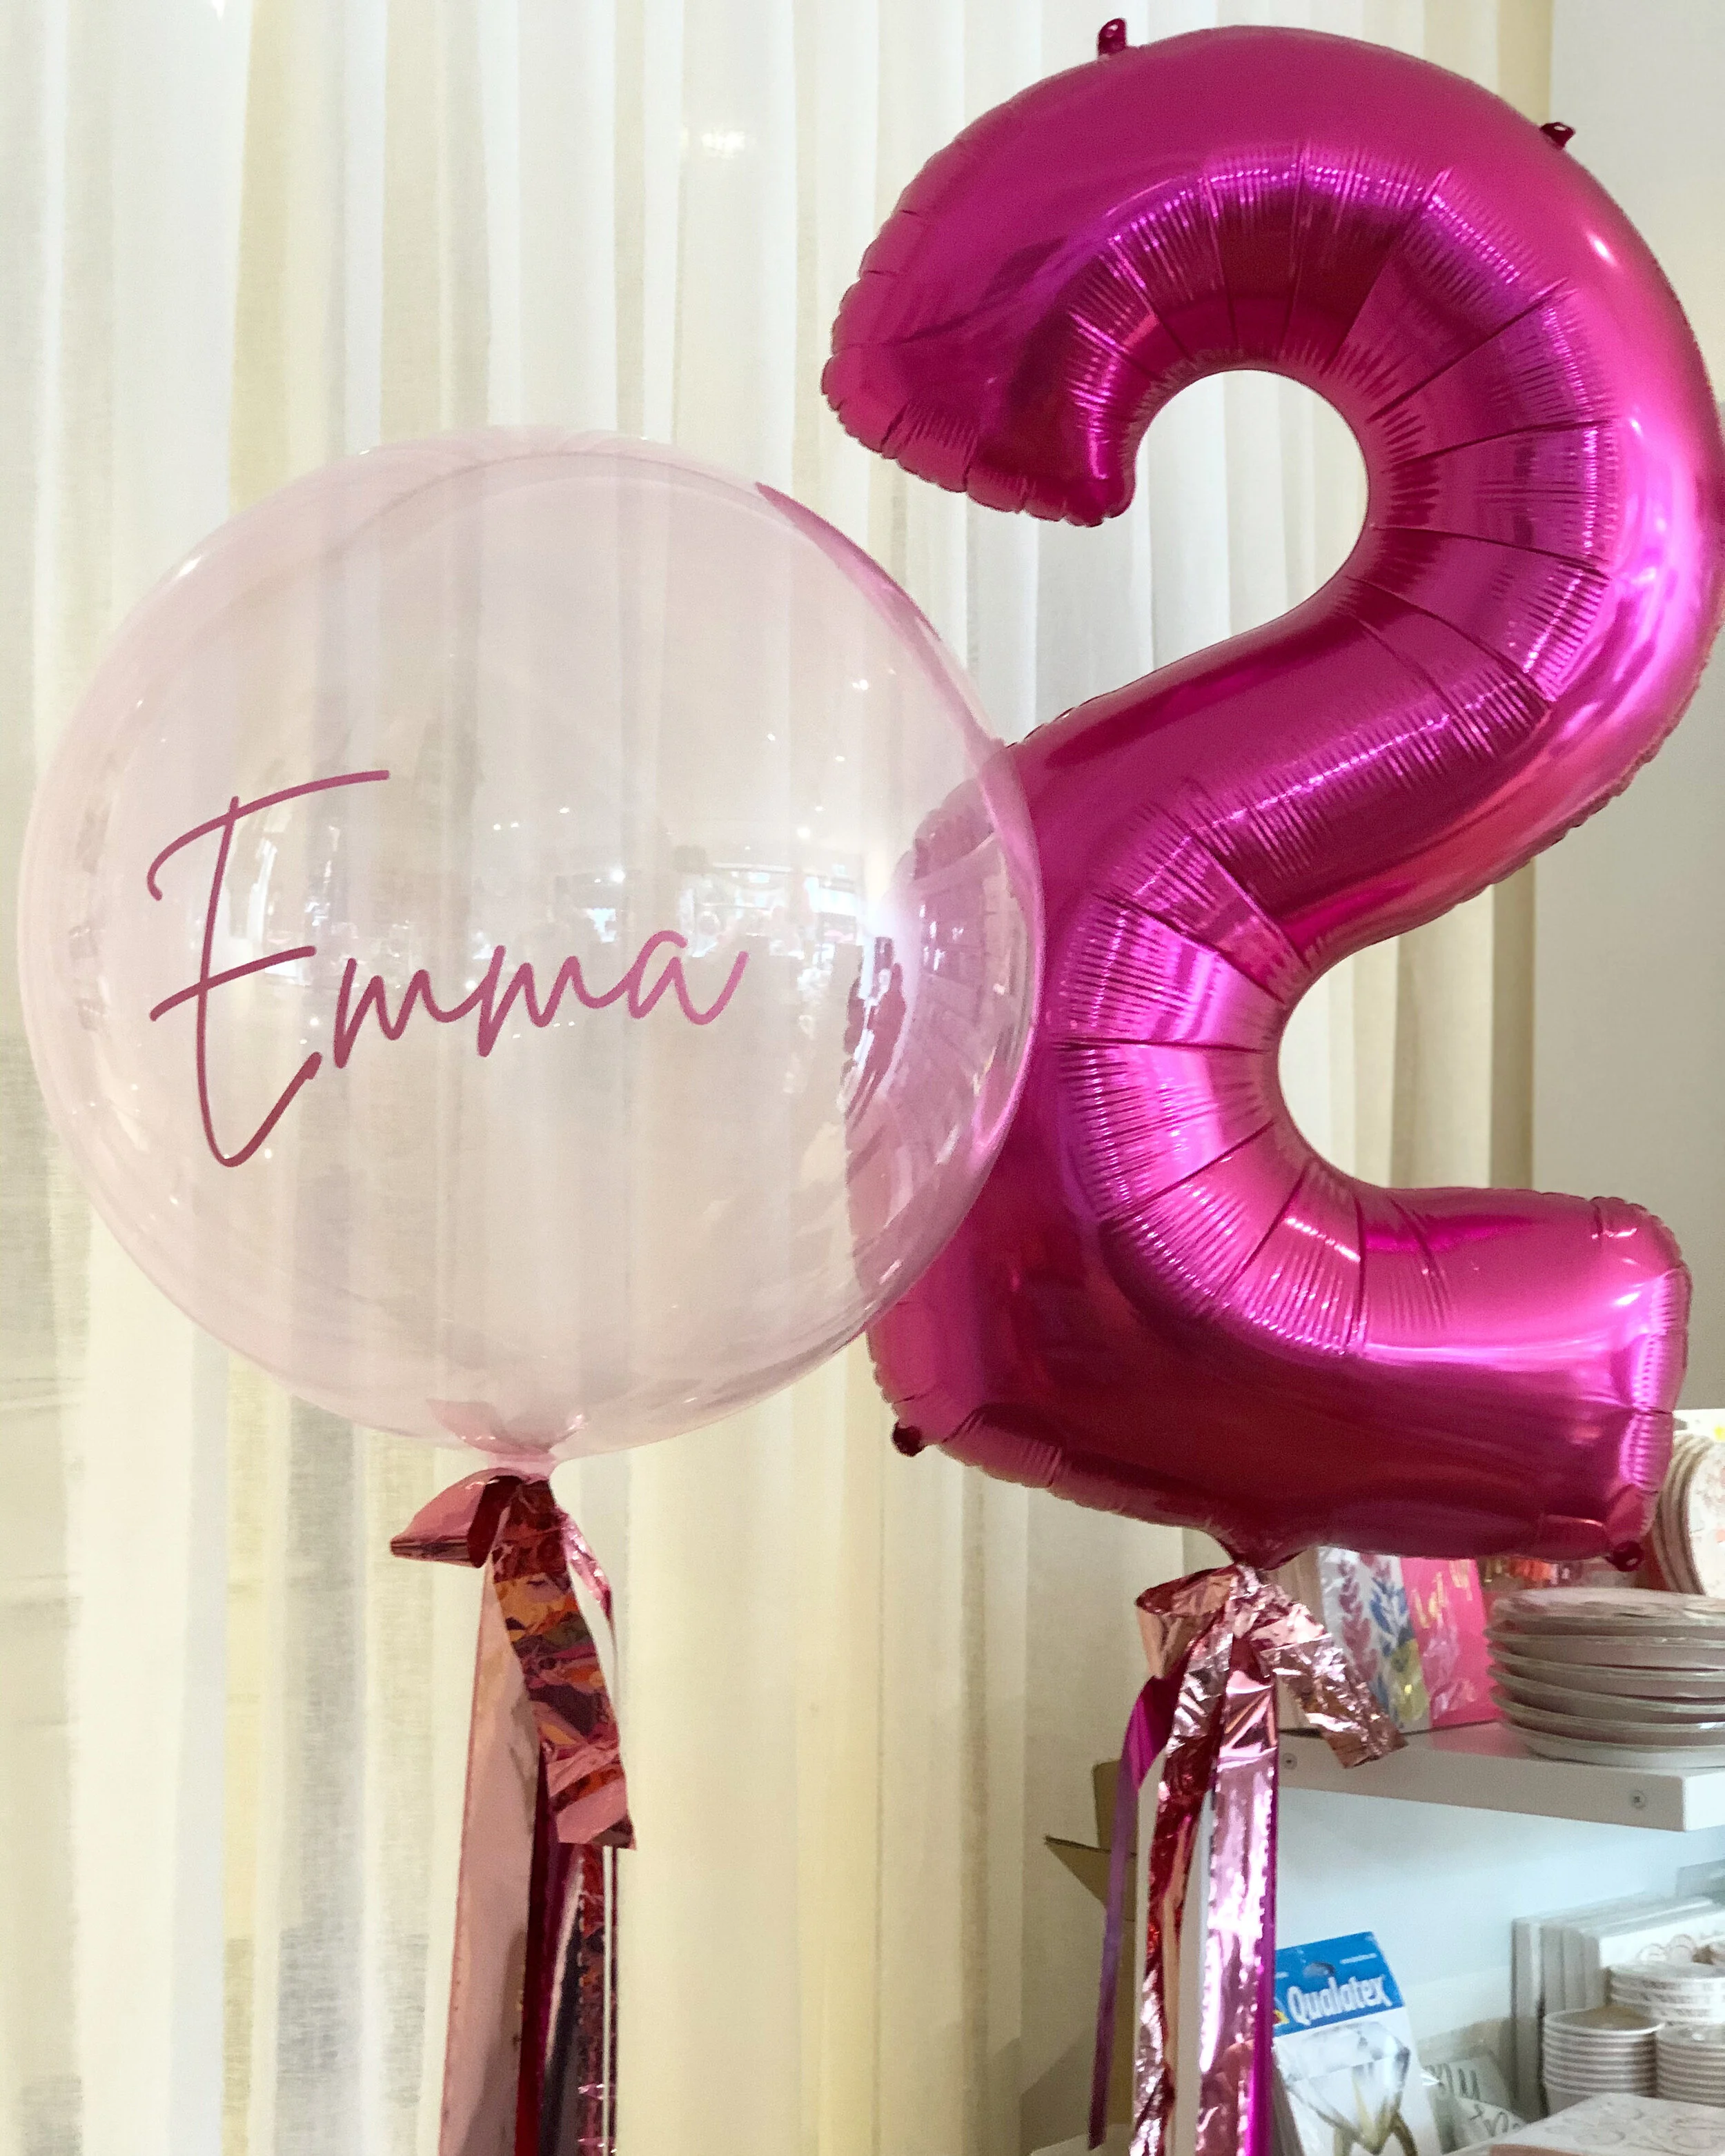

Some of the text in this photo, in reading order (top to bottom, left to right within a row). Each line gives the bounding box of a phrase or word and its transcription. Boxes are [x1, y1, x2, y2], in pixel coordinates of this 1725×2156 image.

[148, 770, 749, 1167] Emma
[822, 23, 1725, 1563] 2
[1287, 1975, 1392, 2026] Qualatex
